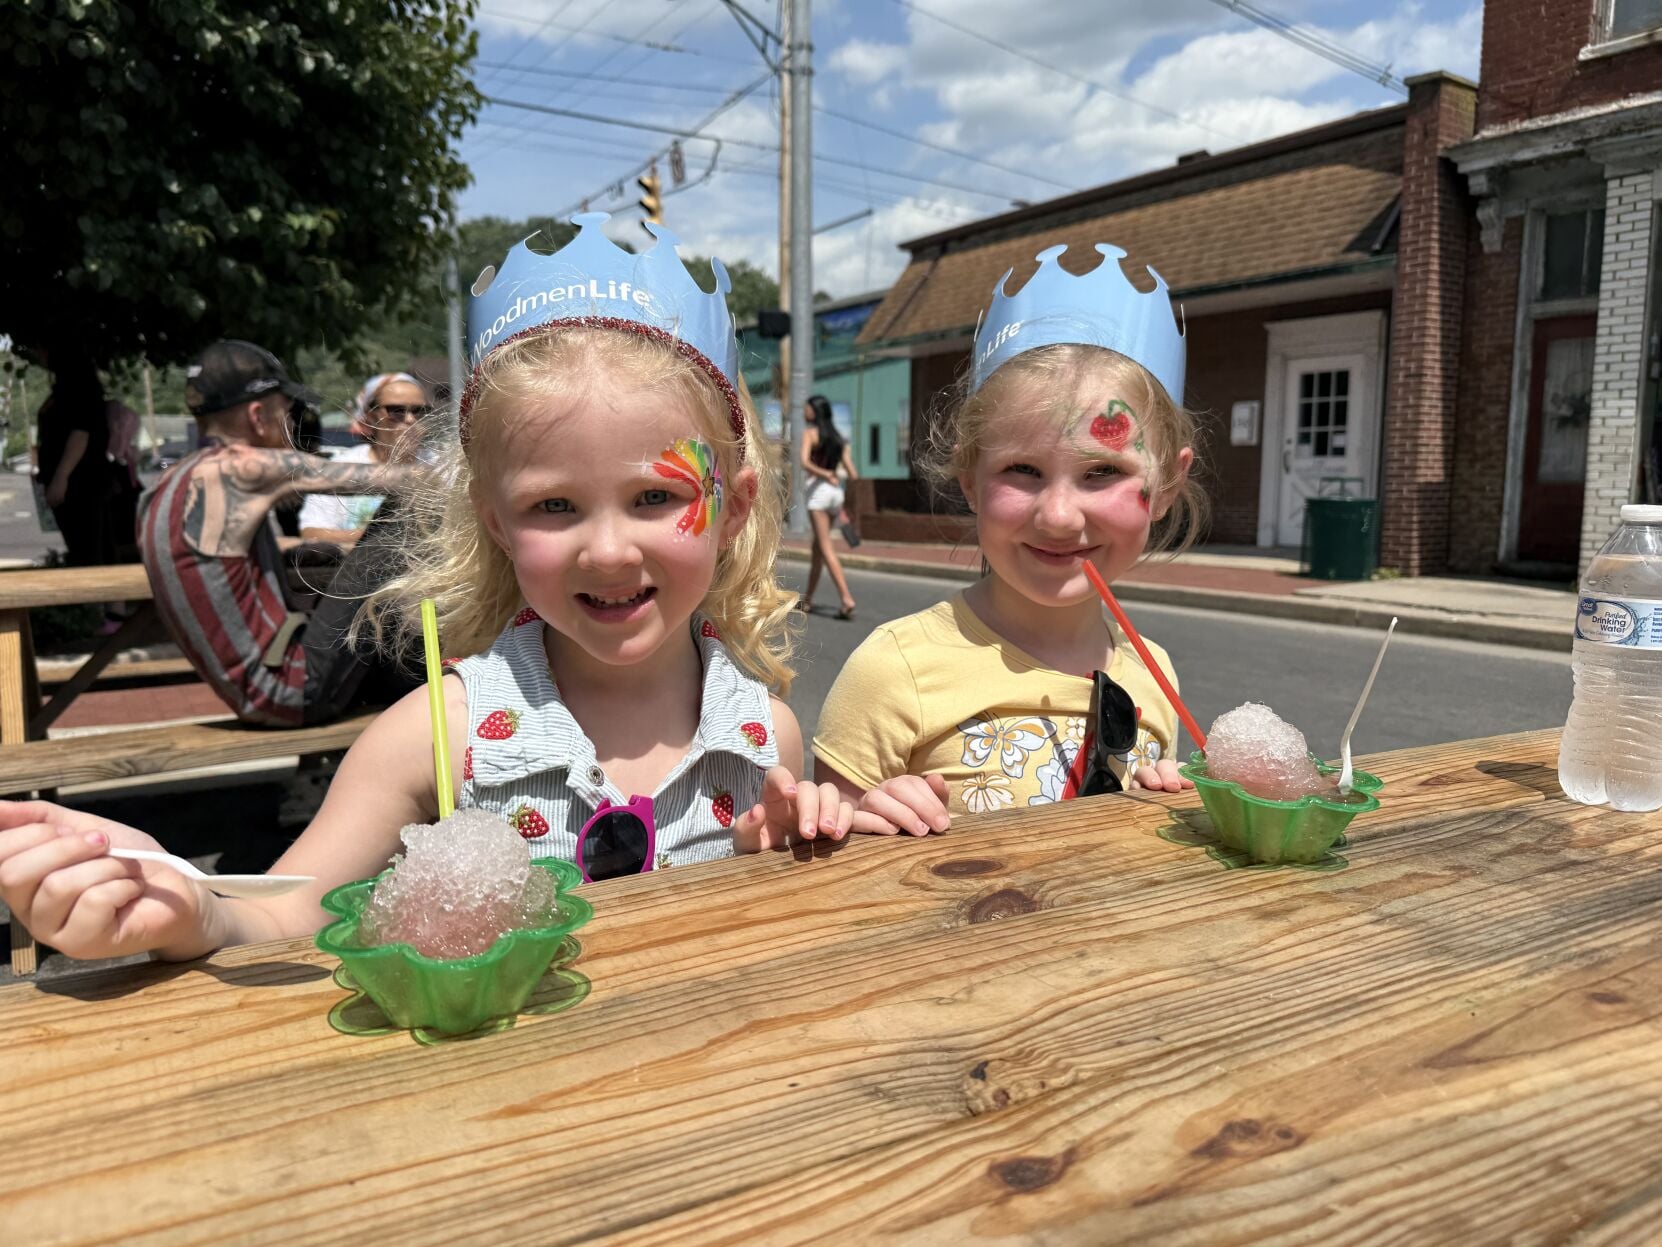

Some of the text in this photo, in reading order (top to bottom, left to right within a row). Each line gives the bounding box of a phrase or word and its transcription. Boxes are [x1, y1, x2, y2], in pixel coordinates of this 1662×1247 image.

[471, 280, 651, 364] WoodmenLife
[1592, 616, 1626, 627] Drinking
[1600, 624, 1626, 633] Water
